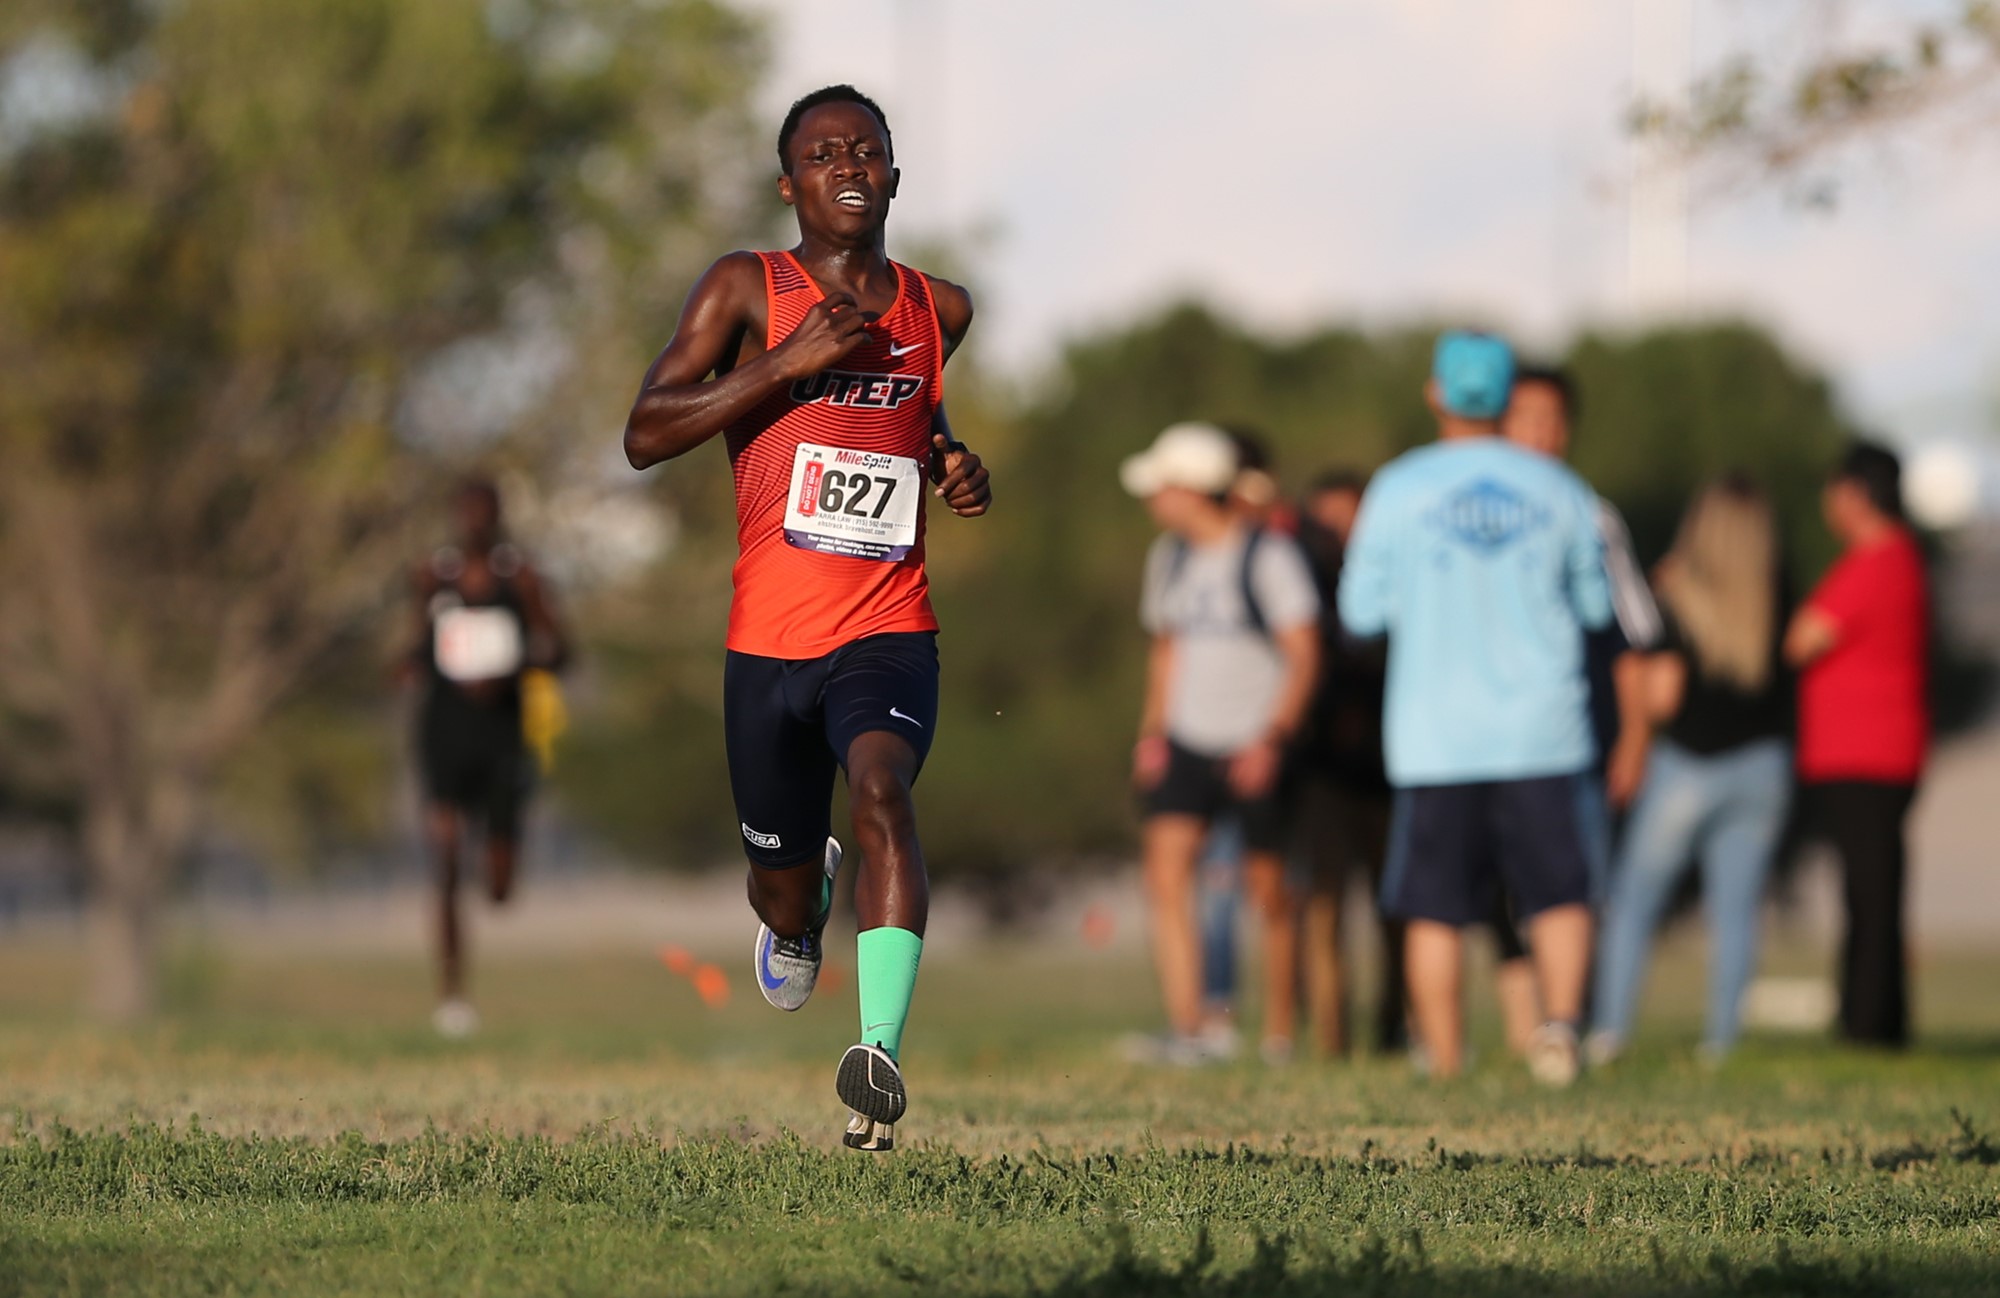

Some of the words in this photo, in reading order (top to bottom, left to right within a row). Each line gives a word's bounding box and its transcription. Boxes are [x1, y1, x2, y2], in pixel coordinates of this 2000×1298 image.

[789, 368, 923, 409] UTEP
[834, 450, 892, 470] MileSplit
[818, 469, 897, 519] 627
